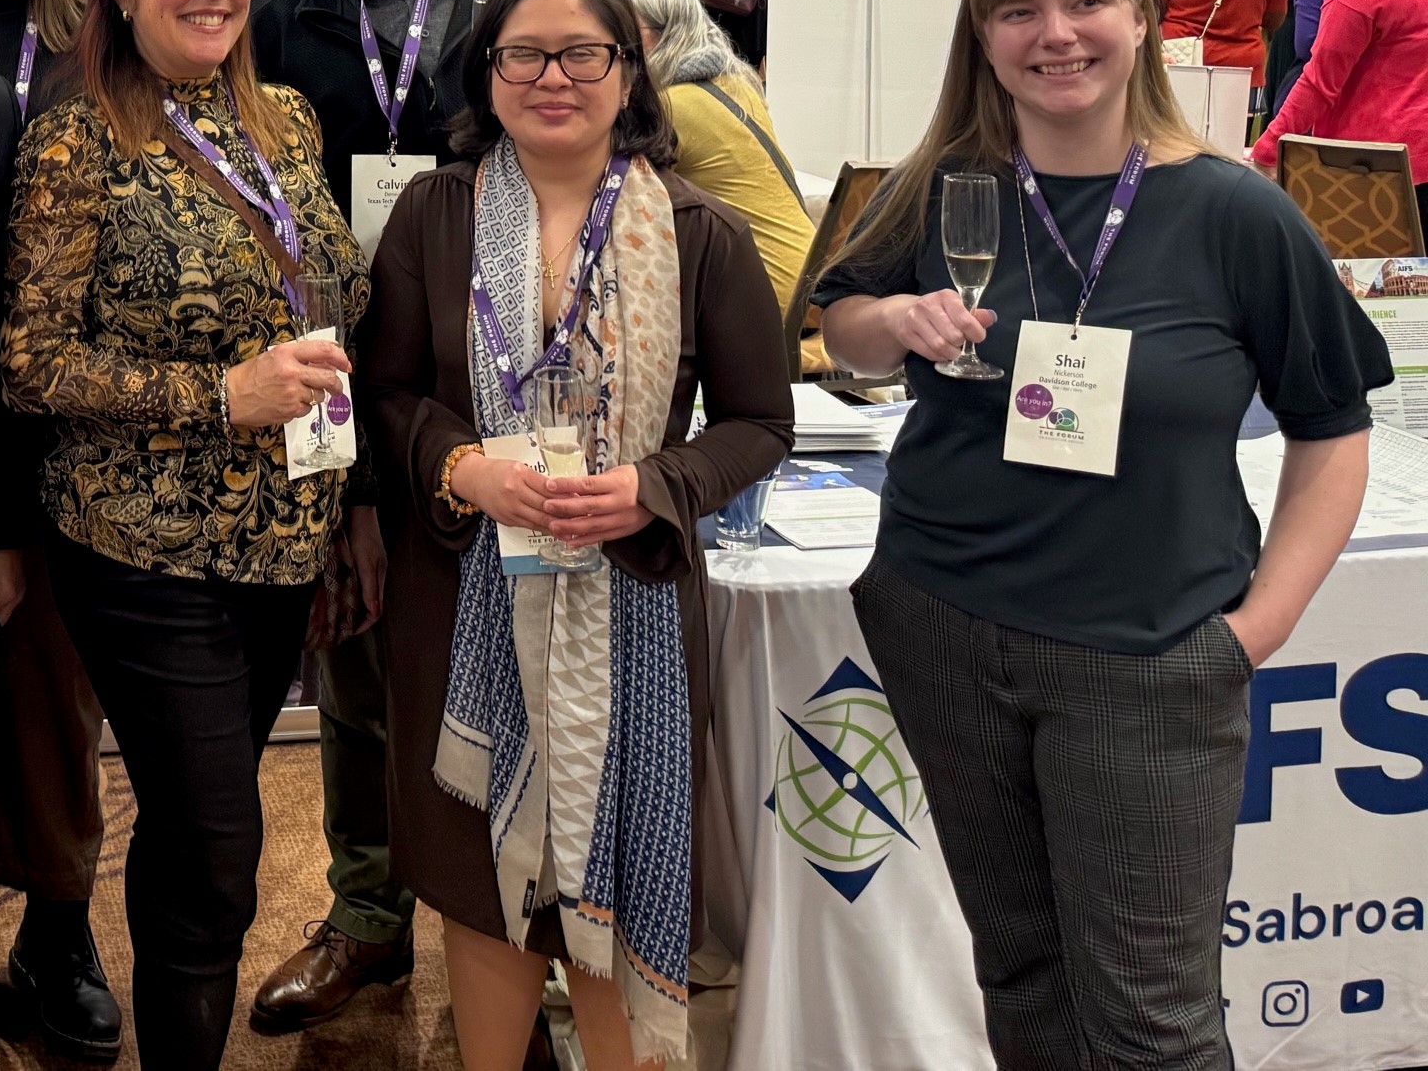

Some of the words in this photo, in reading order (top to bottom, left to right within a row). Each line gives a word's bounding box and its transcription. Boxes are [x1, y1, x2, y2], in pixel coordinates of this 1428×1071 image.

[176, 112, 188, 125] THE
[187, 124, 204, 143] FORUM
[1137, 149, 1145, 163] THE
[1129, 164, 1139, 185] FORUM
[608, 192, 616, 205] THE
[600, 206, 610, 227] FORUM
[1106, 228, 1116, 241] THE
[1095, 242, 1108, 265] FORUM
[483, 314, 493, 339] FORUM
[491, 339, 499, 353] THE
[1055, 353, 1086, 369] Shai
[1054, 369, 1084, 379] Nickerson
[1038, 376, 1070, 386] Davidson
[1071, 379, 1097, 390] College
[1016, 395, 1027, 404] Are
[1028, 398, 1041, 406] you
[1042, 399, 1052, 407] in?
[1057, 432, 1084, 440] FORUM
